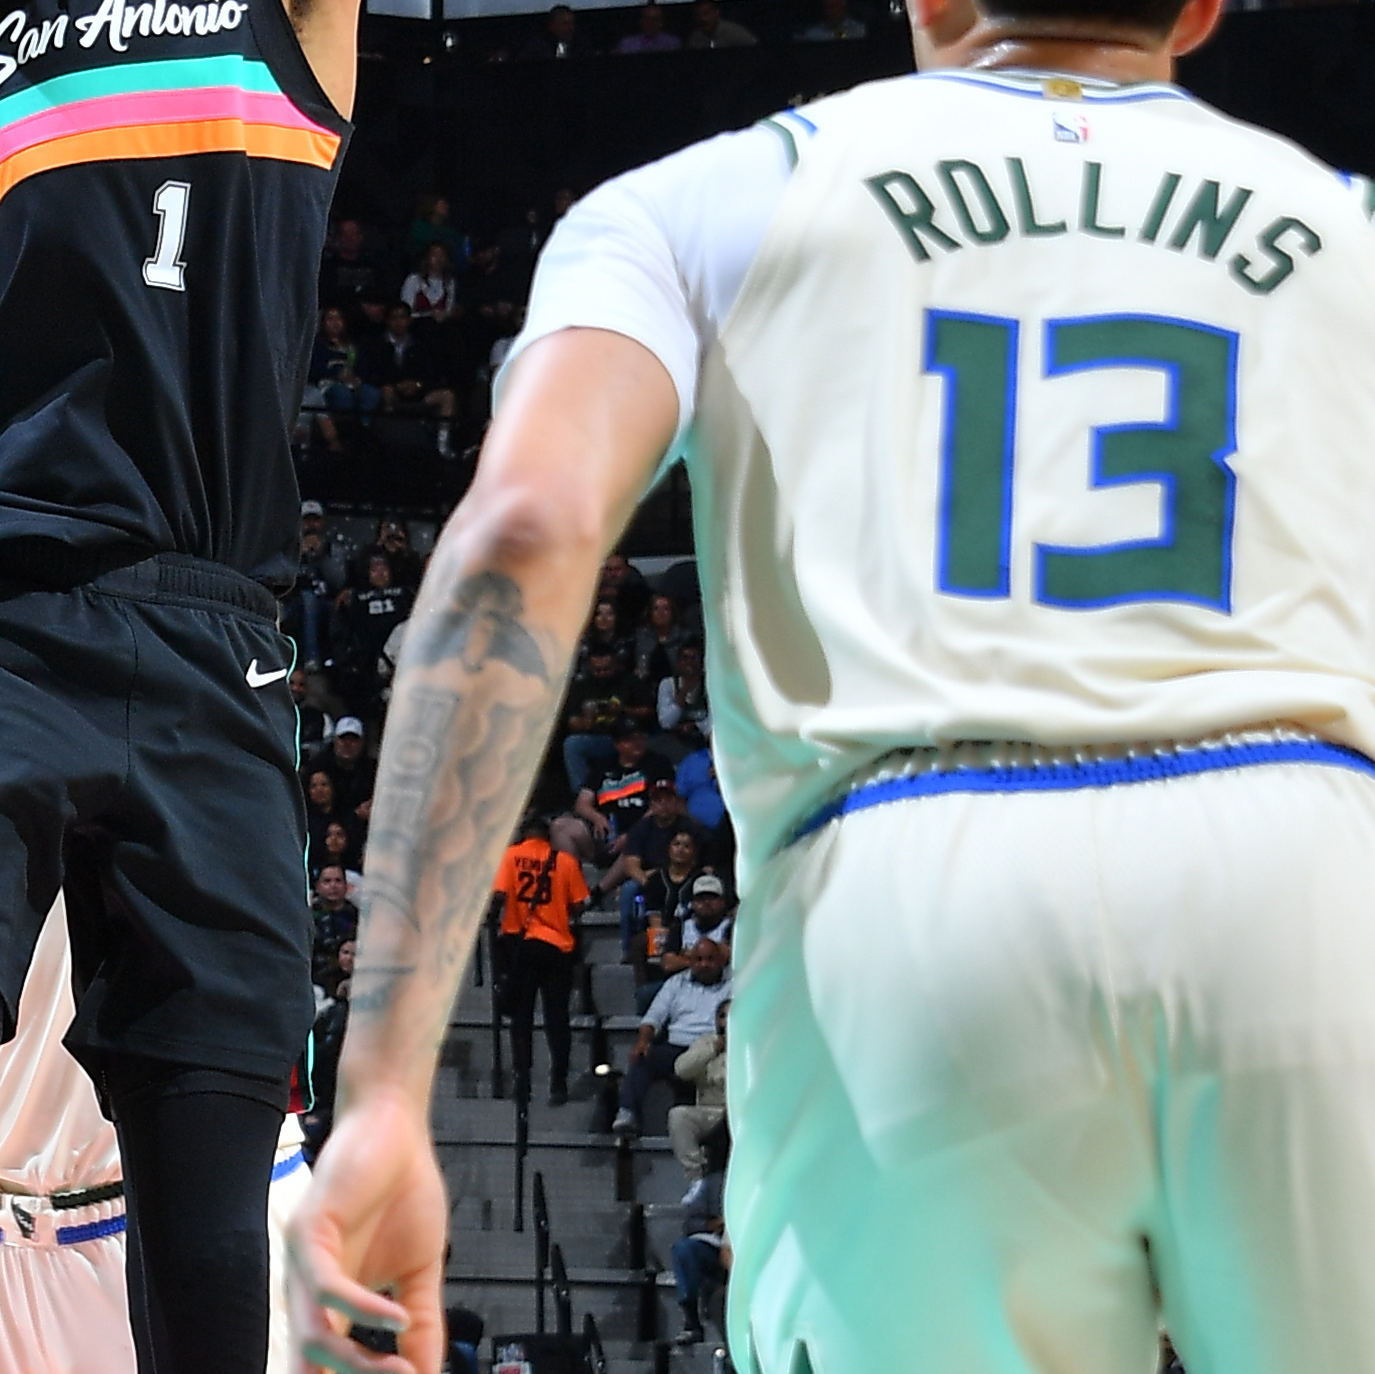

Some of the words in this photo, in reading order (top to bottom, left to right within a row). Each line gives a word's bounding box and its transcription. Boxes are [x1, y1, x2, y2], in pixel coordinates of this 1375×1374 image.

[141, 179, 193, 293] 1
[863, 156, 1324, 296] ROLLINS
[923, 306, 1242, 615] 13
